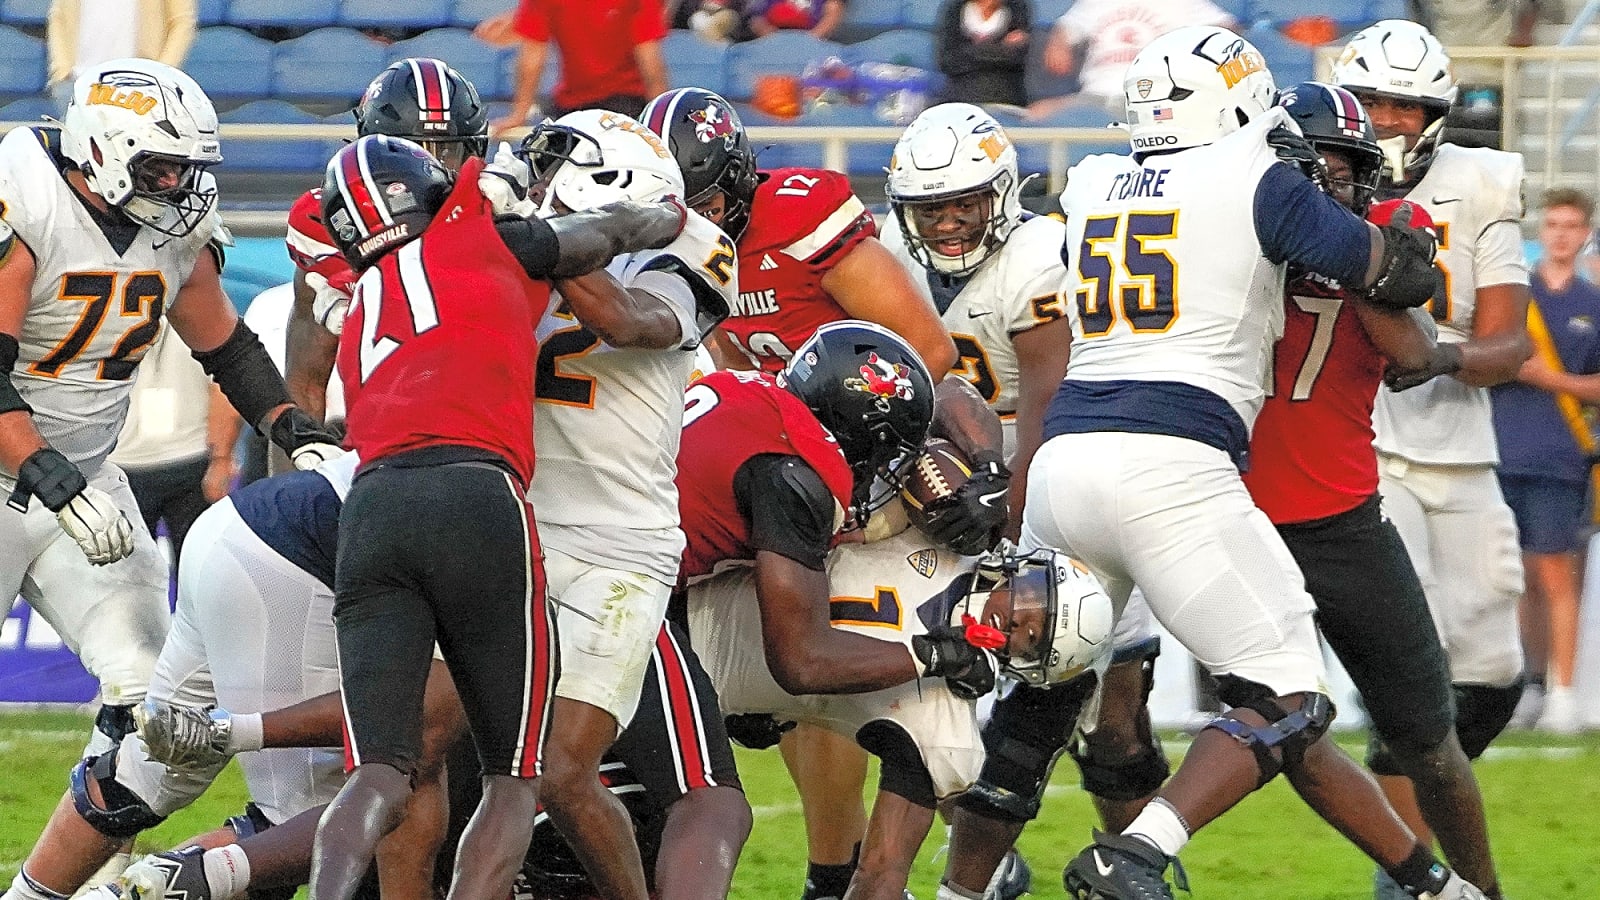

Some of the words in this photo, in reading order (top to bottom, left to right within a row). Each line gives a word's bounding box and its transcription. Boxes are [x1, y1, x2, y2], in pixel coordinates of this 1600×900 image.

[86, 83, 158, 115] TOLEDO
[1133, 135, 1178, 149] TOLEDO
[775, 174, 820, 197] 12
[358, 223, 410, 257] LOUISVILLE
[702, 233, 736, 287] 2
[1075, 208, 1181, 340] 55
[28, 271, 167, 381] 72
[346, 236, 440, 386] 21
[729, 288, 781, 318] VILLE
[1267, 295, 1344, 401] 7
[829, 585, 904, 632] 1
